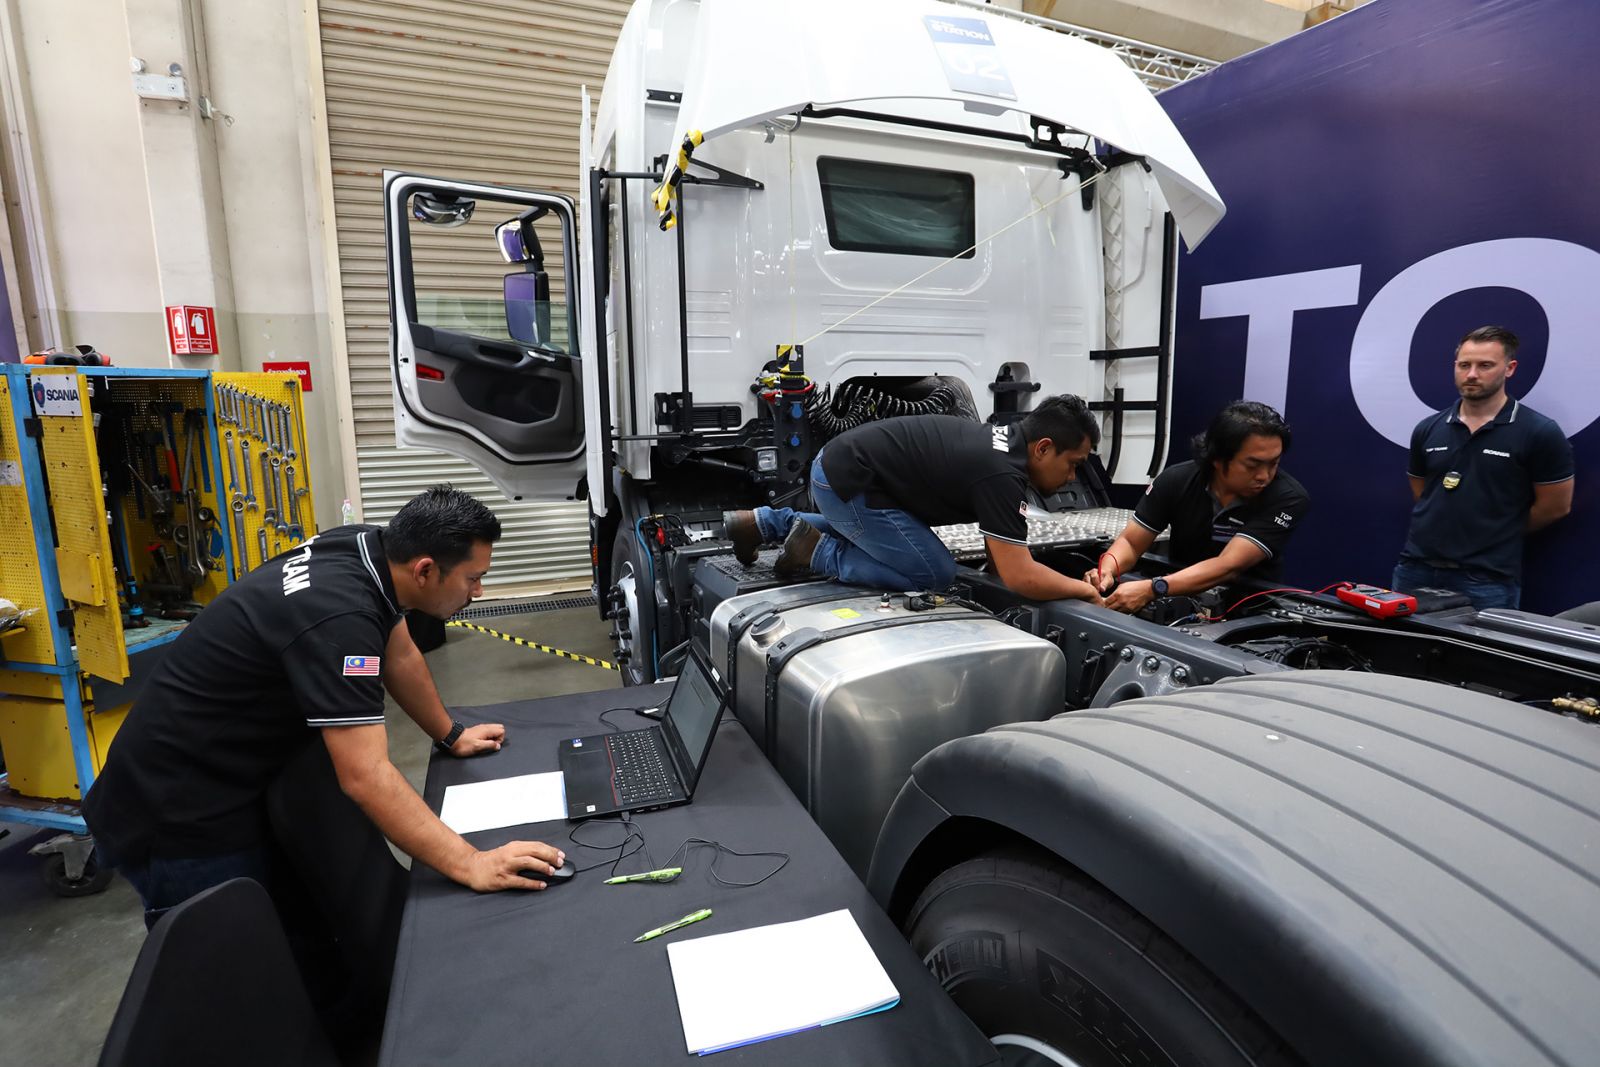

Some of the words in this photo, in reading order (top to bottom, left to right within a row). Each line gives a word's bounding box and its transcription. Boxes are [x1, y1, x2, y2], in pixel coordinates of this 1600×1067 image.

[1199, 236, 1600, 450] TO
[46, 389, 79, 401] SCANIA
[1280, 511, 1292, 521] TOP
